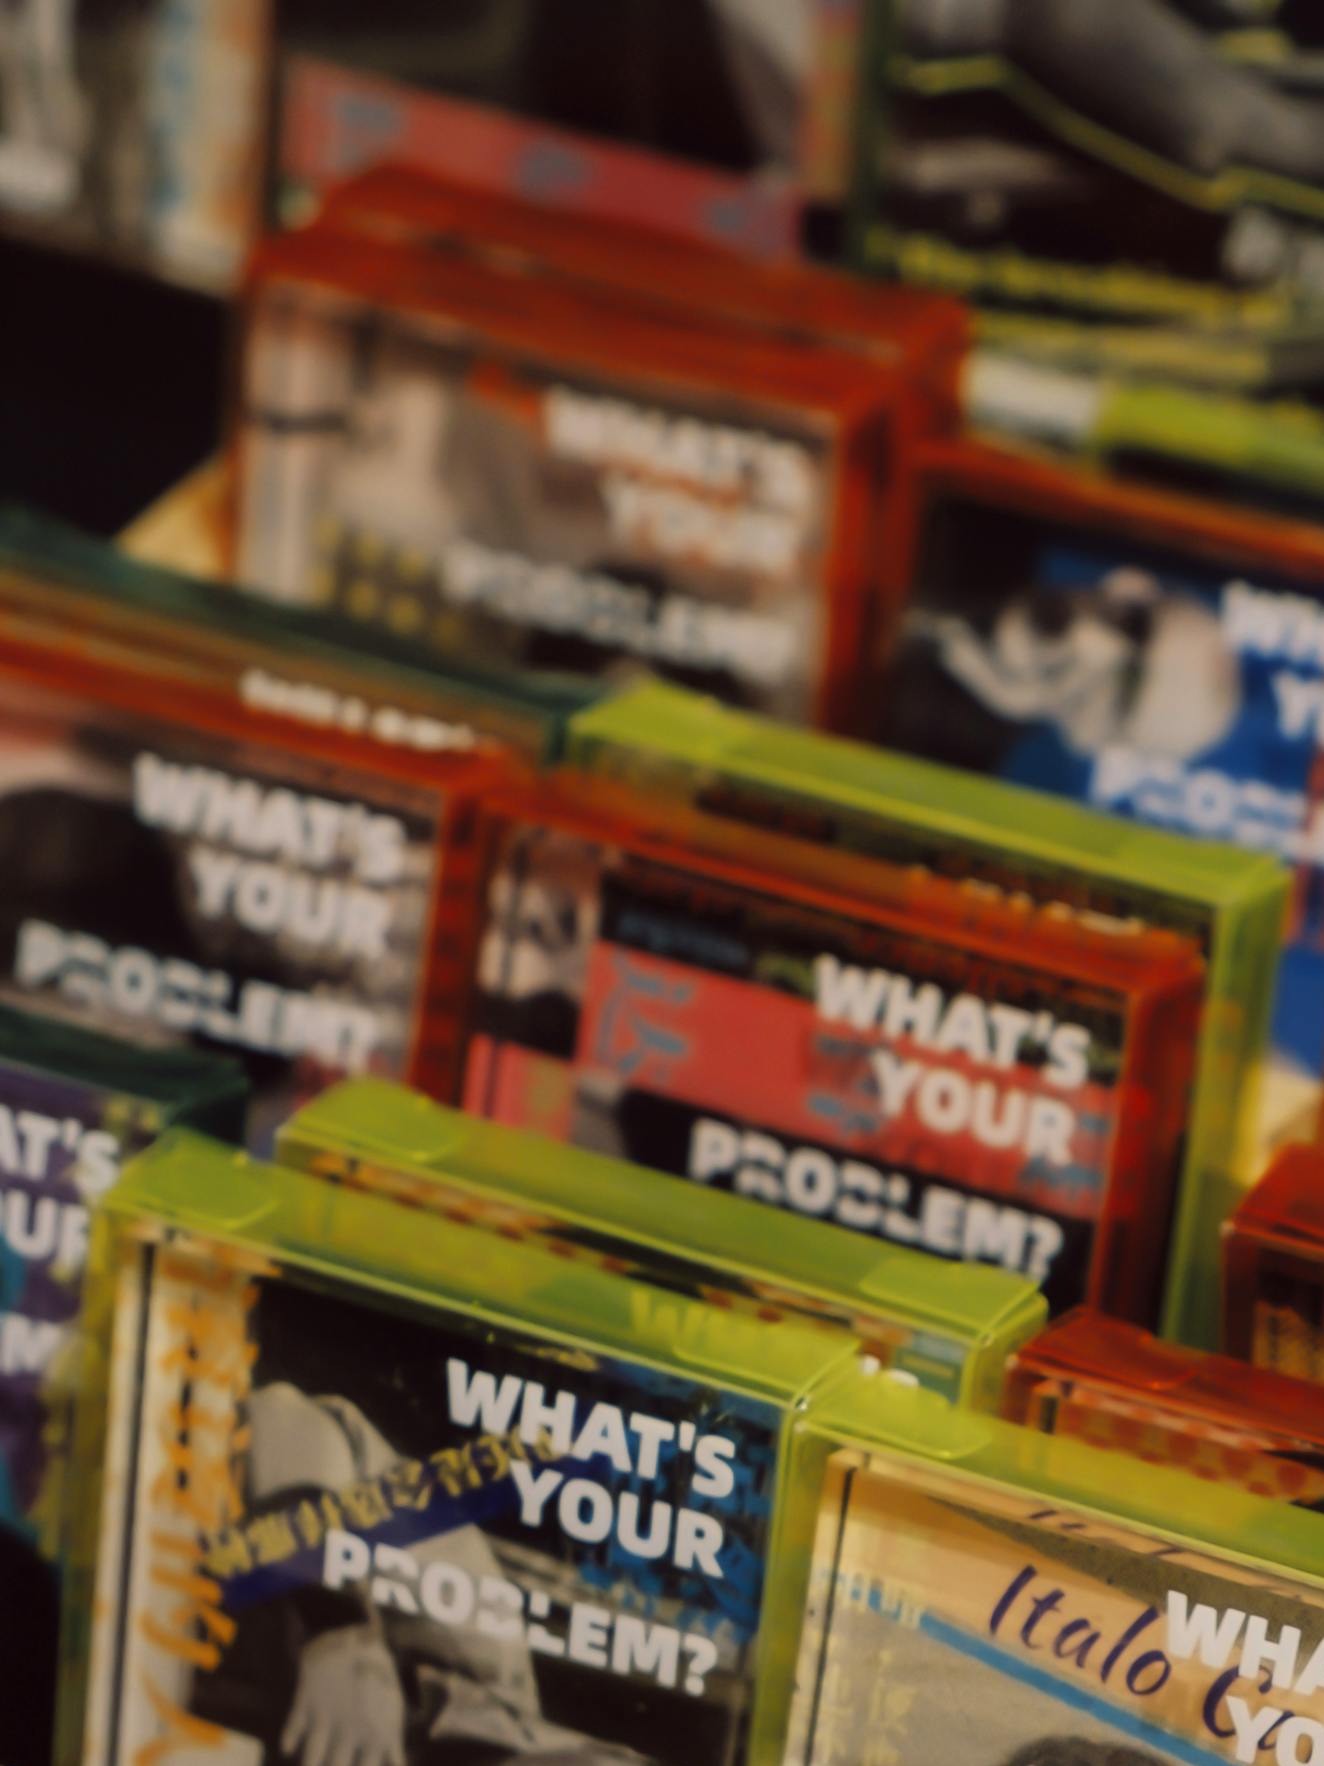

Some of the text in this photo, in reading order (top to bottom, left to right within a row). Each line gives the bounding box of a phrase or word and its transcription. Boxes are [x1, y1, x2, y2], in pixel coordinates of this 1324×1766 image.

[134, 753, 407, 882] WHAT'S
[191, 849, 391, 958] YOUR
[814, 955, 1092, 1088] WHAT'S
[870, 1050, 1075, 1166] YOUR
[690, 1118, 1063, 1281] PROBLEM?
[447, 1358, 736, 1499] WHAT'S
[509, 1459, 725, 1580] YOUR
[322, 1530, 717, 1697] PROBLEM?
[989, 1566, 1171, 1696] Italo
